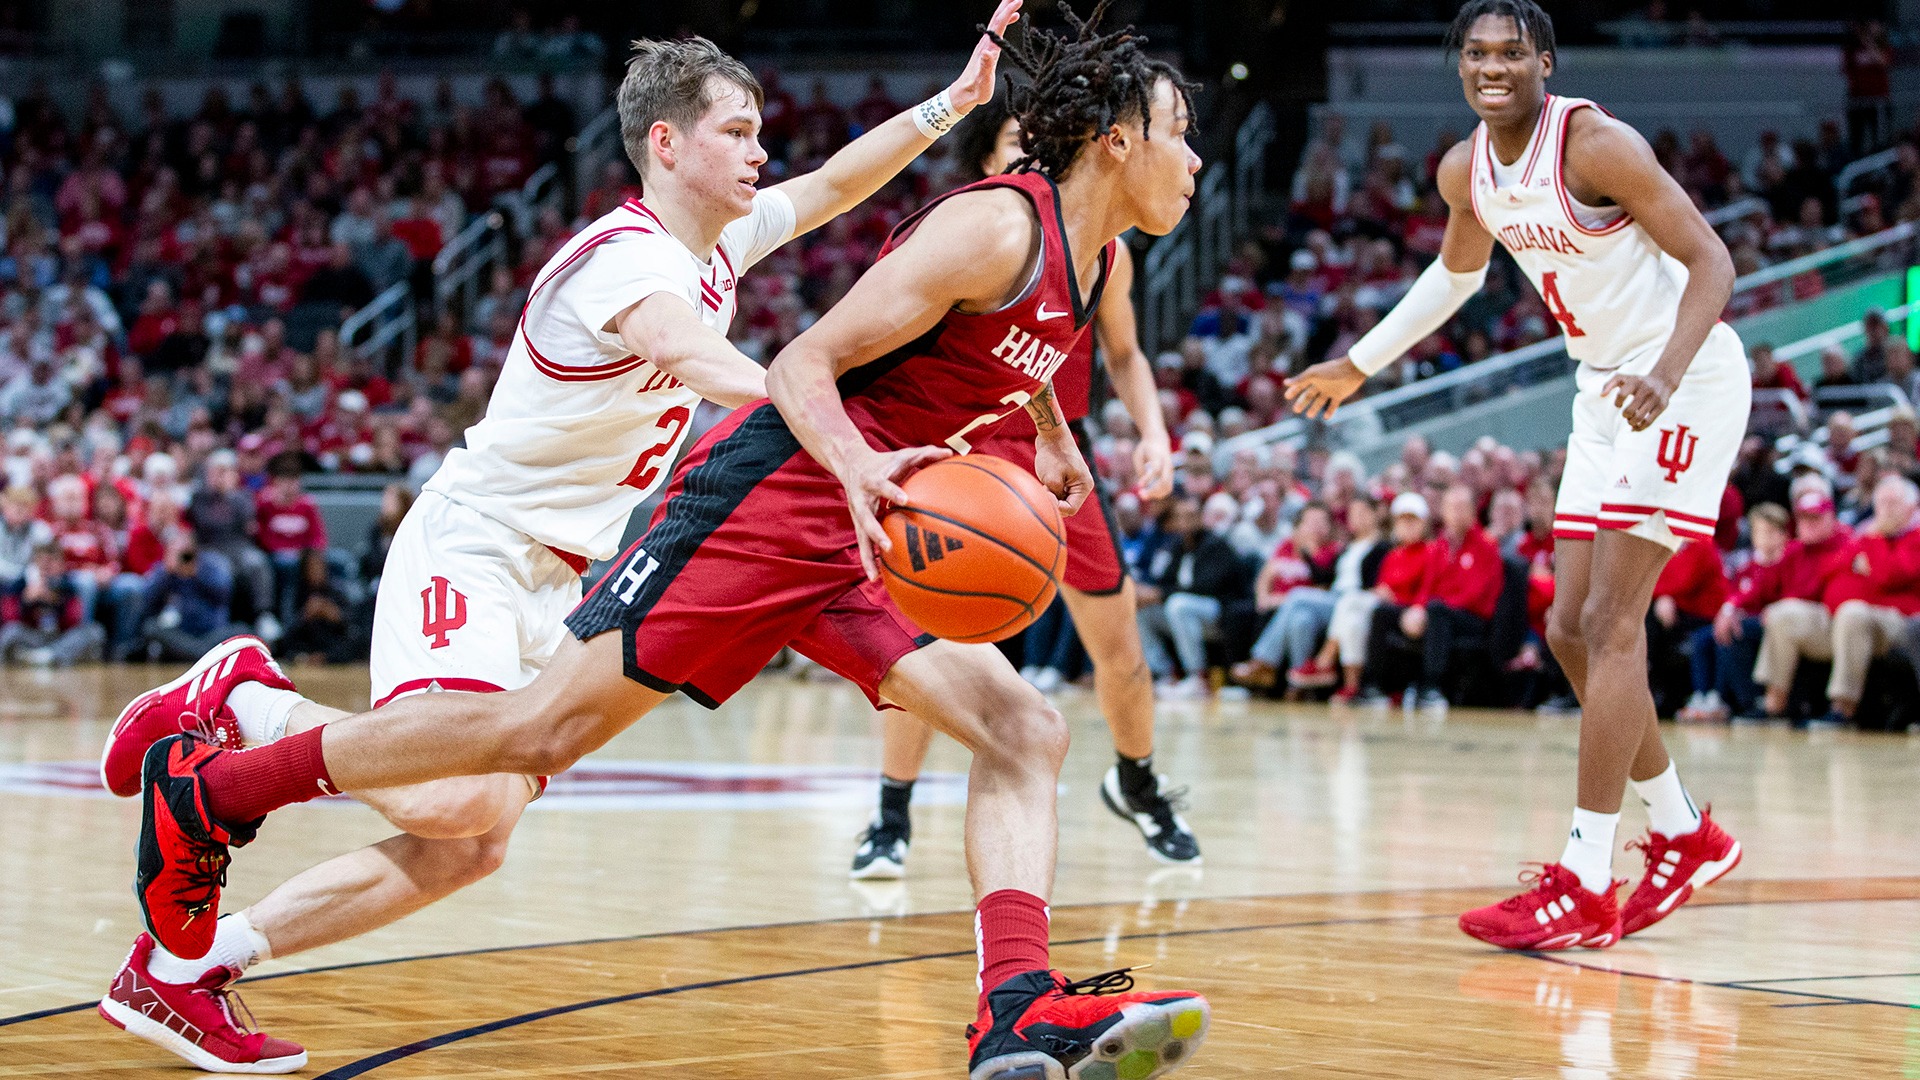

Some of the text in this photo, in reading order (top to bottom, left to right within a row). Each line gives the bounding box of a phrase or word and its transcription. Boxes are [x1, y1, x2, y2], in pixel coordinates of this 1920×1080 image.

[1498, 222, 1585, 255] NDIANA
[1542, 271, 1586, 338] 4
[991, 324, 1069, 384] HARV
[616, 405, 690, 490] 2
[610, 548, 661, 606] H
